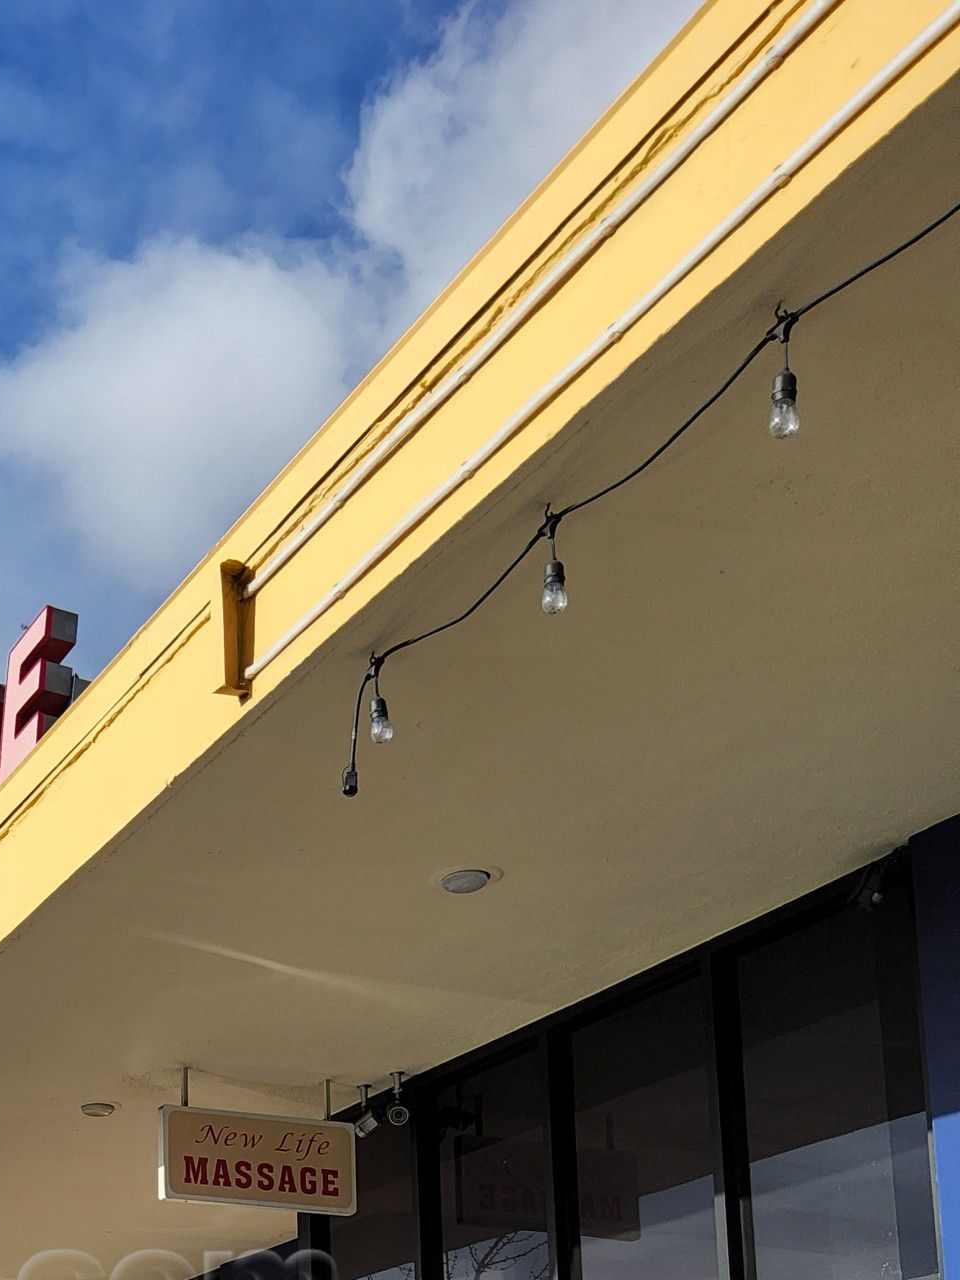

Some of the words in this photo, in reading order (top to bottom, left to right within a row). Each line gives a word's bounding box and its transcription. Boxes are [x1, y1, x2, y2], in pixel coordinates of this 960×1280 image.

[195, 1124, 263, 1149] New
[274, 1132, 330, 1161] Life
[184, 1155, 339, 1197] MASSAGE
